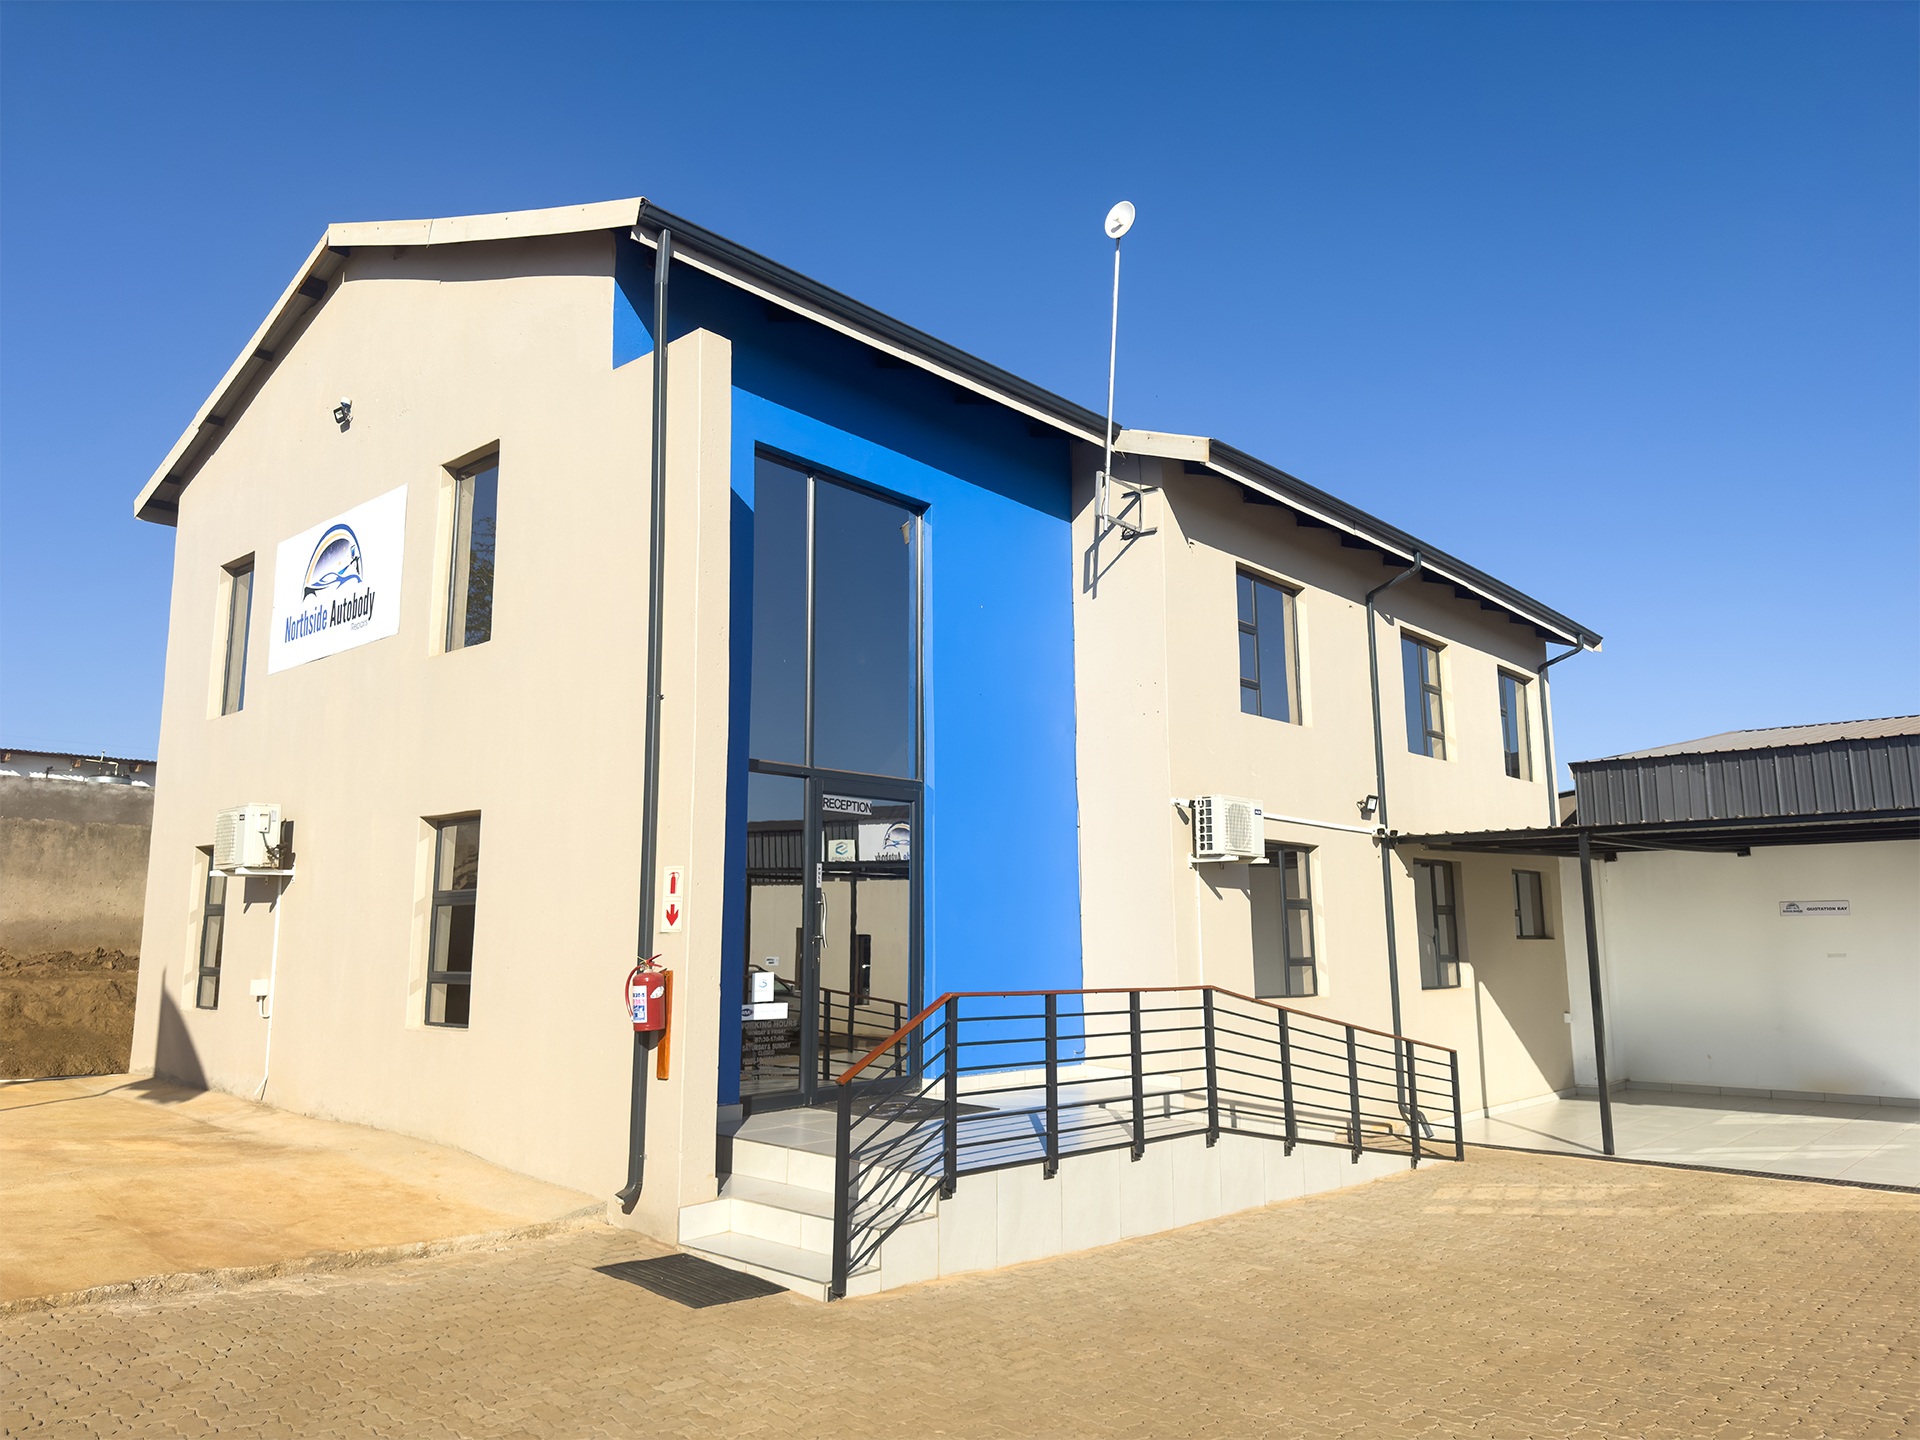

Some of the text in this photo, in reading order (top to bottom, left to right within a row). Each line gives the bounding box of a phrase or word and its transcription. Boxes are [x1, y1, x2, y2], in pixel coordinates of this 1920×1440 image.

[284, 587, 376, 643] Northside Autobody
[823, 797, 872, 813] RECEPTION
